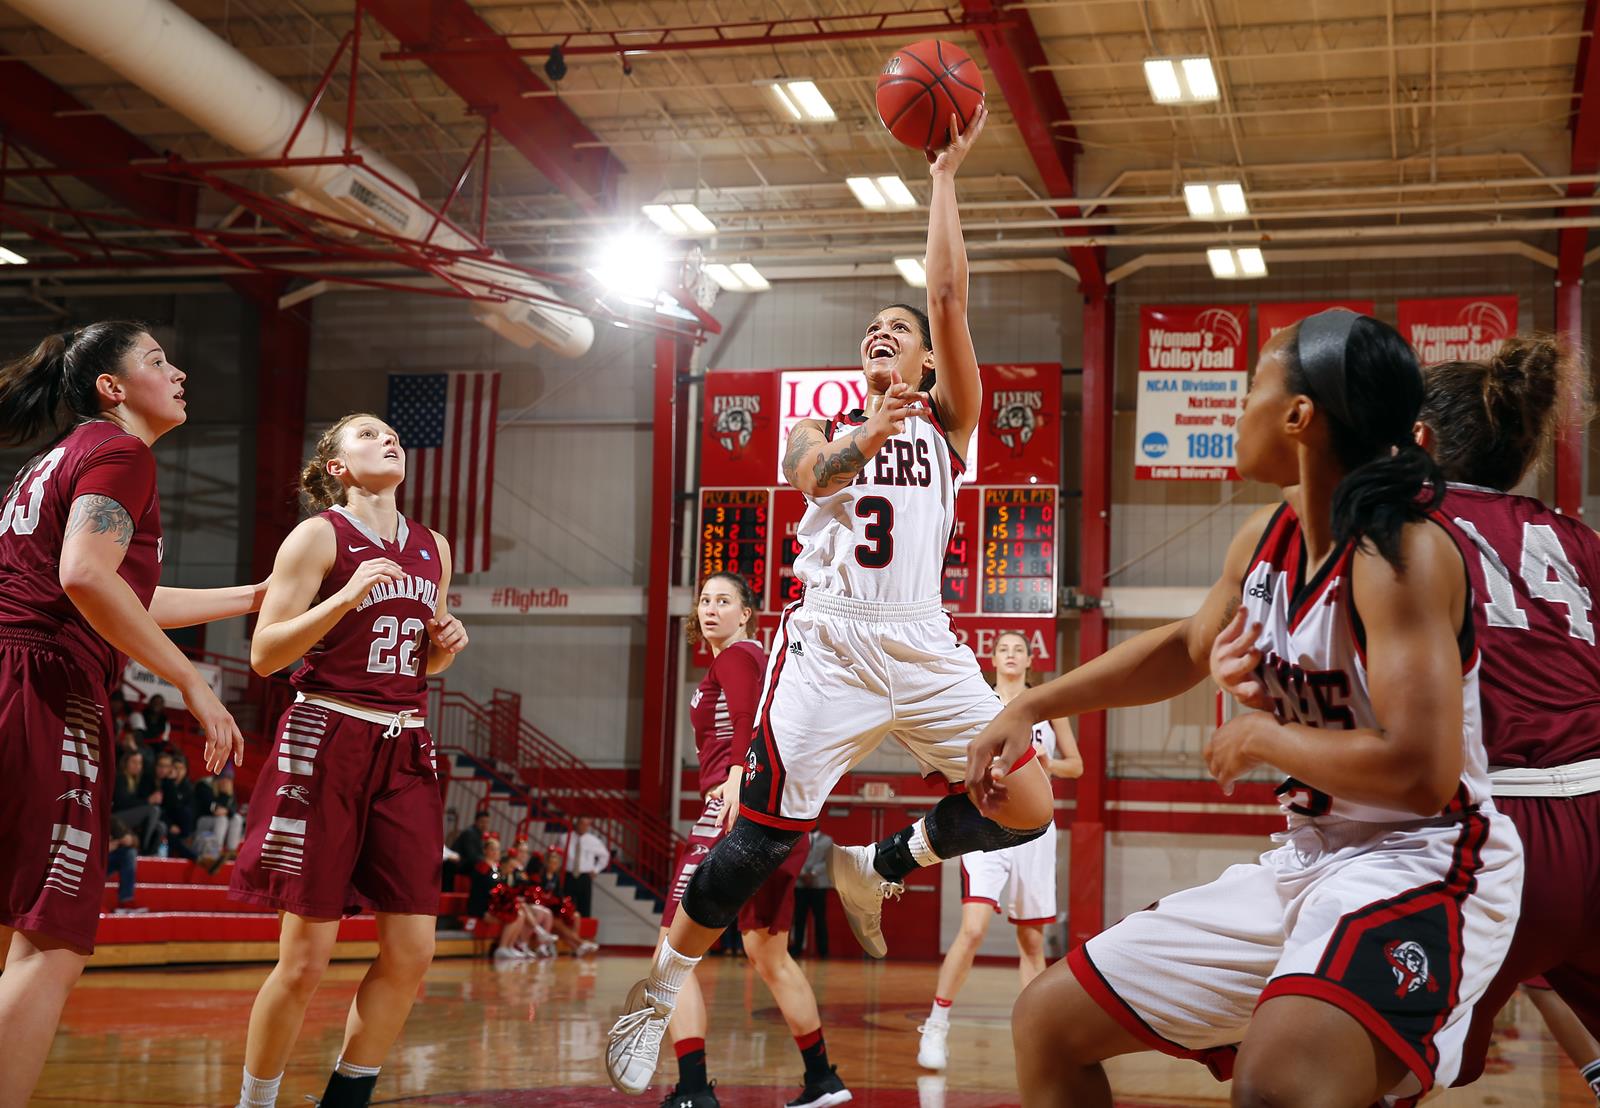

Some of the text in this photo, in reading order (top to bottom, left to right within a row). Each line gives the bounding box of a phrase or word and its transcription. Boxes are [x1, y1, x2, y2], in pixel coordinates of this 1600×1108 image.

[1149, 328, 1213, 348] Women's
[1411, 323, 1482, 341] Women's
[1149, 346, 1234, 371] Volleyball
[1146, 380, 1178, 392] NCAA
[1182, 380, 1227, 392] Division
[713, 395, 760, 415] FLYERS
[993, 391, 1042, 411] FLYERS
[1187, 396, 1236, 408] National
[1187, 433, 1233, 458] 1981
[716, 507, 725, 523] 3
[998, 506, 1008, 522] 5
[1041, 506, 1052, 522] 0
[704, 523, 725, 540] 24
[729, 523, 740, 540] 2
[855, 495, 893, 569] 3
[992, 523, 1008, 539] 15
[705, 542, 723, 558] 32
[728, 542, 739, 558] 0
[753, 559, 765, 575] 0
[986, 559, 1008, 575] 22
[1453, 516, 1596, 646] 14
[490, 587, 569, 614] #FlightOn
[366, 615, 425, 677] 22
